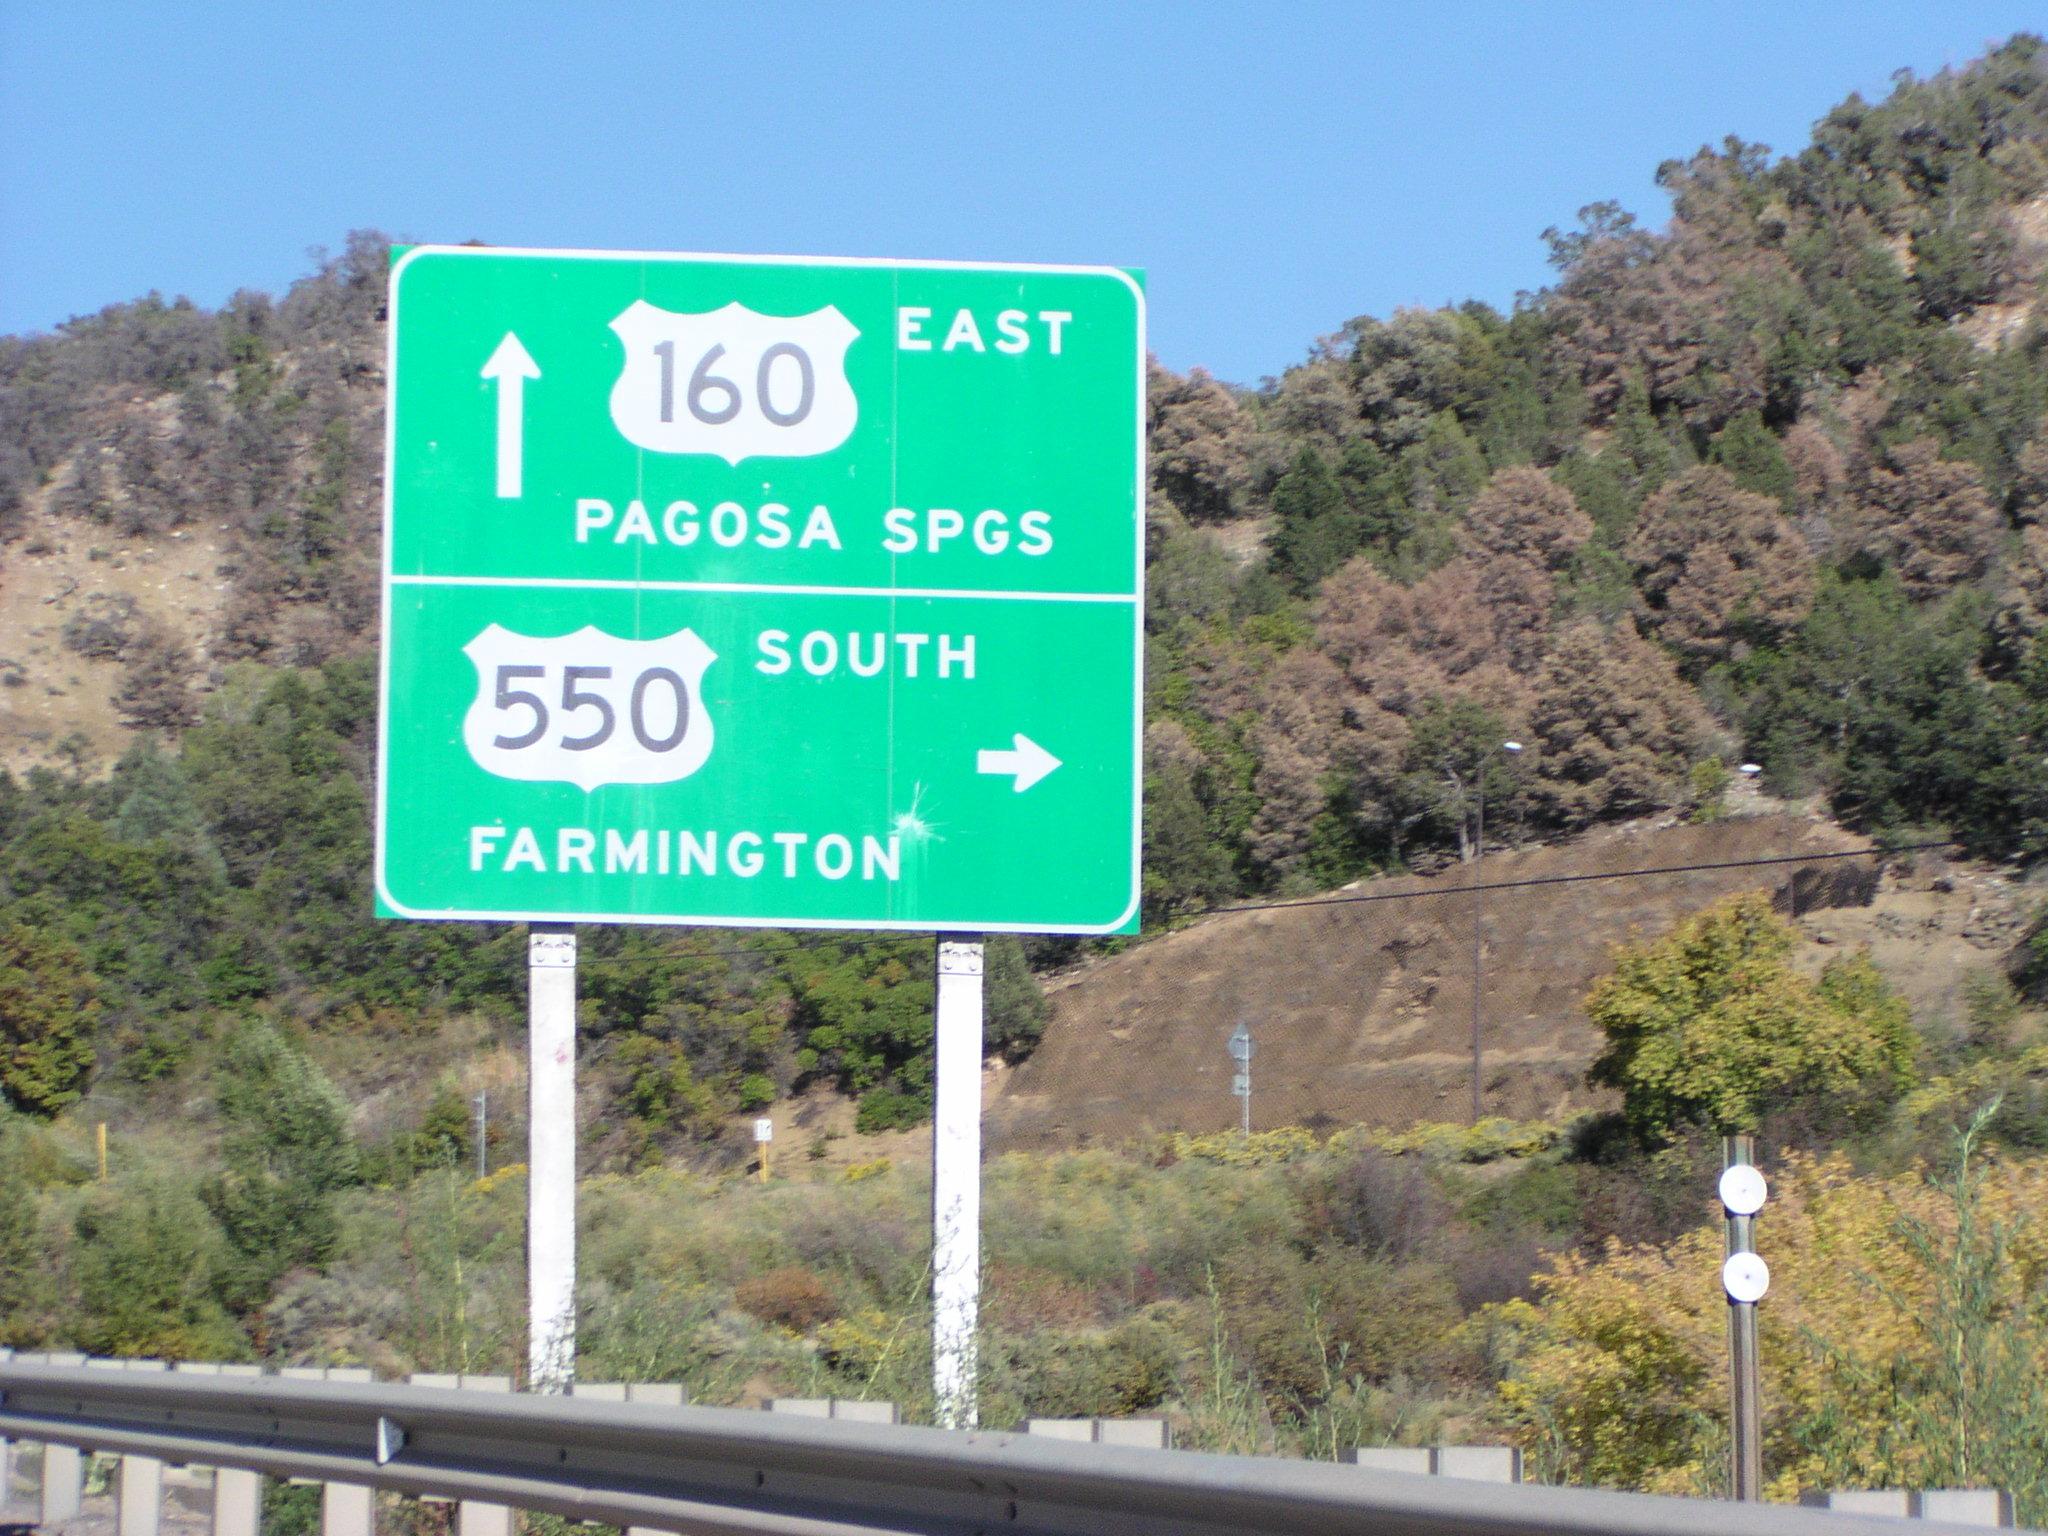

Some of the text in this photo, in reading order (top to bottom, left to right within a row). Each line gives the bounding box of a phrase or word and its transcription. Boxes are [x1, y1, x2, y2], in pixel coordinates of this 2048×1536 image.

[898, 306, 1072, 354] EAST
[654, 340, 815, 427] 160
[576, 498, 1053, 556] PAGOSA SPGS
[756, 629, 975, 679] SOUTH
[494, 664, 690, 754] 550
[470, 826, 901, 881] FARMINGTON
